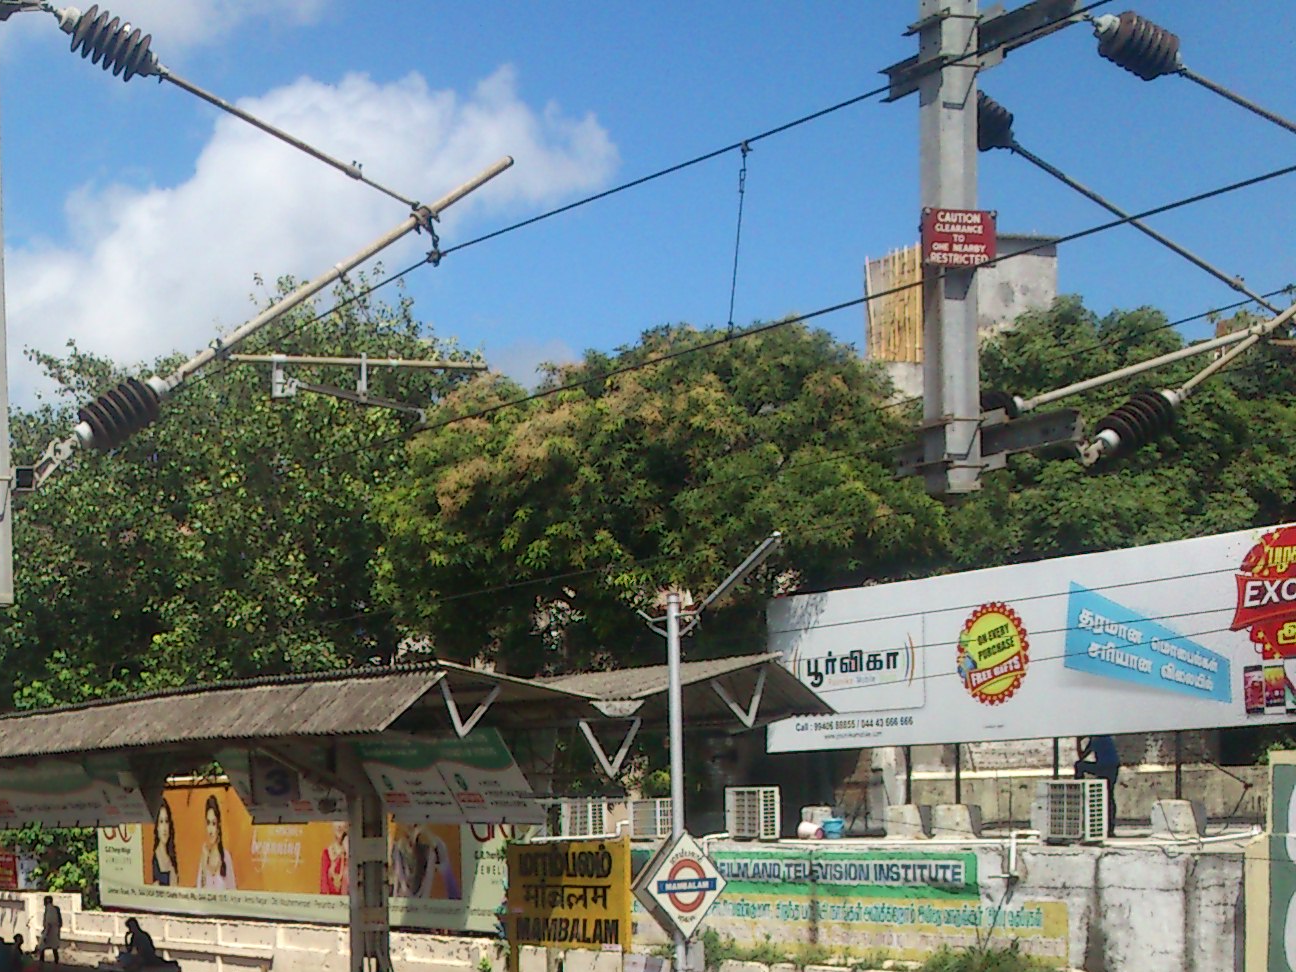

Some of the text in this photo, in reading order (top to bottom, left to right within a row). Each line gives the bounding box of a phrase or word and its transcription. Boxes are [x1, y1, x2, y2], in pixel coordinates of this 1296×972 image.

[934, 223, 983, 234] CLEARANCE
[937, 211, 981, 223] CAUTION
[931, 242, 949, 251] ONE
[952, 234, 965, 242] TO
[929, 252, 989, 264] RESTRICTED
[977, 623, 1009, 645] ON EVERY
[1078, 608, 1142, 645] தரமான
[978, 636, 1015, 661] PURCHASE
[1088, 641, 1153, 674] சரியான
[807, 650, 899, 687] பூர்விகா
[971, 655, 1021, 688] FREE GIFTS
[796, 723, 808, 731] Call
[519, 844, 612, 878] மாம்பலம்
[717, 859, 963, 884] FILM AND TELEVISION INSTITUTE
[664, 881, 709, 892] MAMBALAM
[516, 917, 619, 944] MAMBALAM
